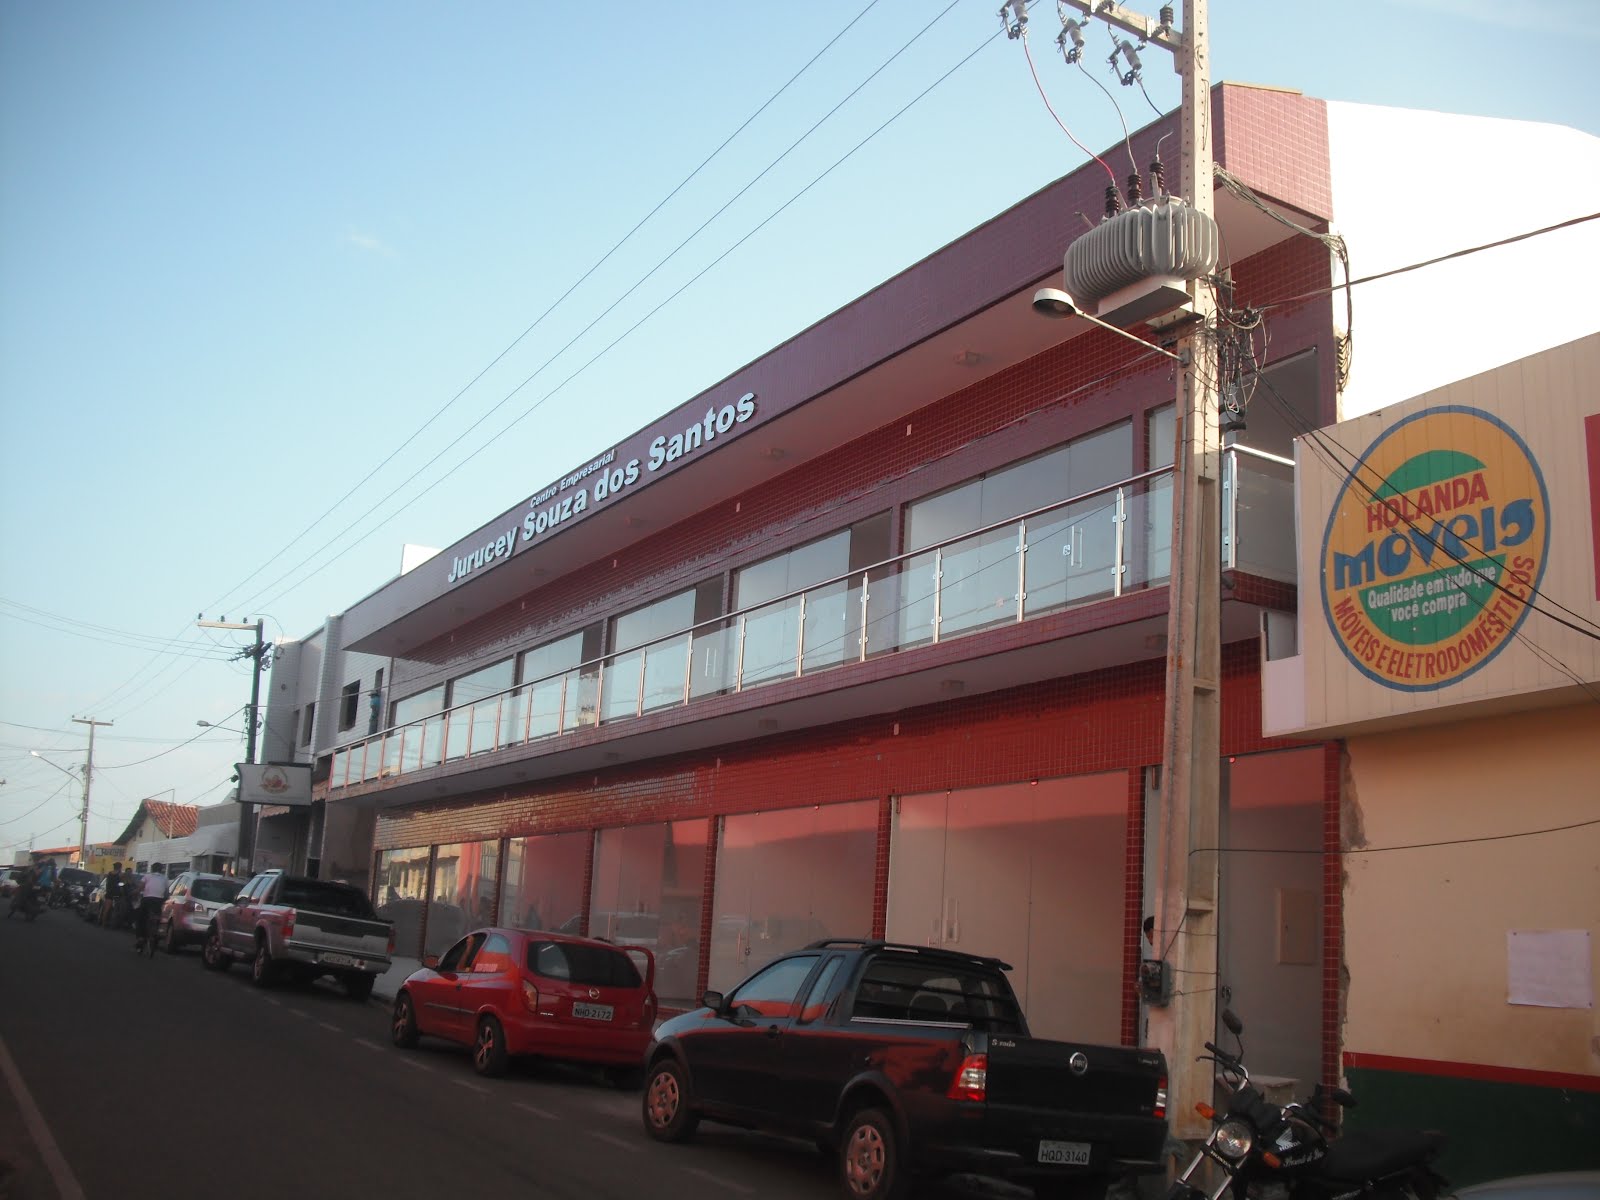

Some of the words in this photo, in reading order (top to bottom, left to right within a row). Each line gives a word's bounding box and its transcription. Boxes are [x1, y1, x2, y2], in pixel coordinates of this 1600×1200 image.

[448, 525, 520, 583] Jurucey
[522, 488, 588, 541] Souza
[593, 459, 641, 502] dos
[647, 392, 757, 471] Santos
[530, 486, 557, 509] Centro
[560, 449, 617, 492] Empresarial
[1367, 472, 1490, 533] HOLANDA
[1333, 597, 1381, 663] MÓVEIS
[1375, 644, 1392, 670] E
[1387, 555, 1536, 680] ELETRODOMÉSTICOS
[1368, 580, 1424, 609] Qualidade
[1426, 576, 1445, 595] em
[1445, 568, 1472, 590] tudo
[1473, 566, 1497, 588] que
[1391, 601, 1419, 622] você
[1422, 591, 1468, 615] compra
